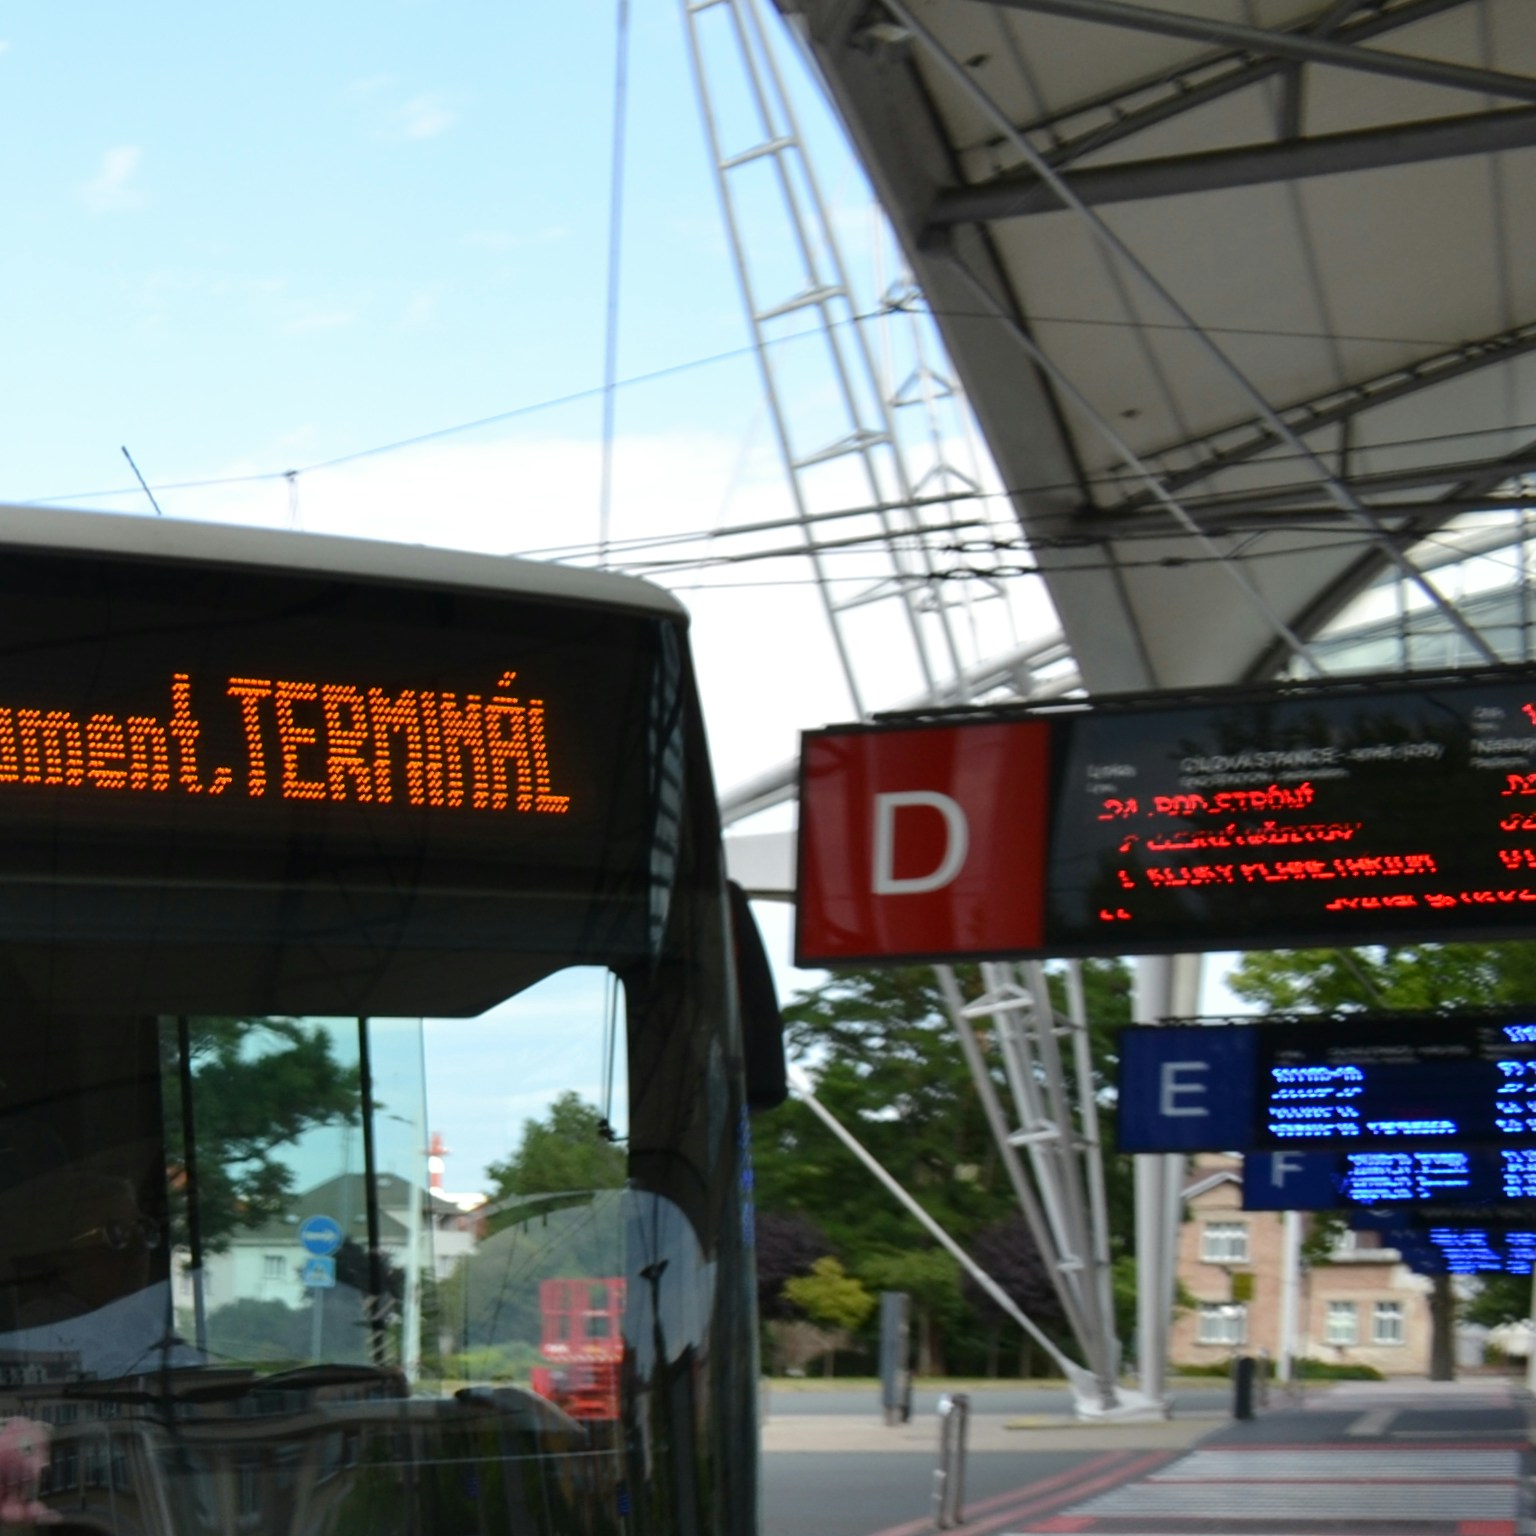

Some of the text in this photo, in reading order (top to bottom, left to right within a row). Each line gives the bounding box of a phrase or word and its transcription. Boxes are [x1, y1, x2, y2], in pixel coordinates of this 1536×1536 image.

[871, 789, 970, 895] D
[1159, 1061, 1211, 1118] E
[1270, 1150, 1305, 1188] F
